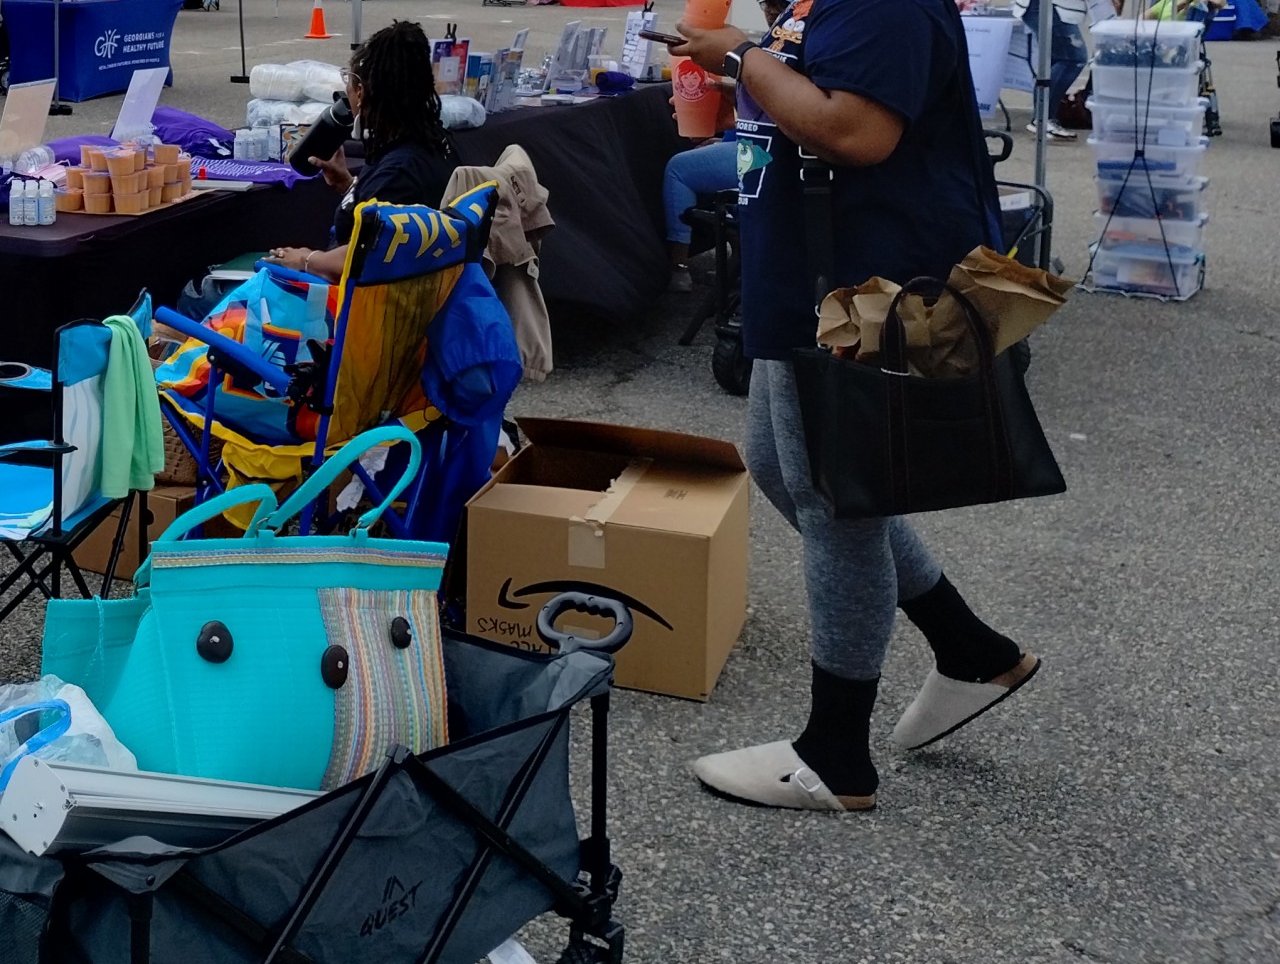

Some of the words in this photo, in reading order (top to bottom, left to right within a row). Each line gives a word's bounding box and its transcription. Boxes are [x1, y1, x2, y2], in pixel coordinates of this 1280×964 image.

[123, 32, 155, 43] GEORGIANS
[123, 43, 146, 53] HEALTHY
[147, 40, 165, 50] FUTURE
[477, 617, 533, 636] MASKS
